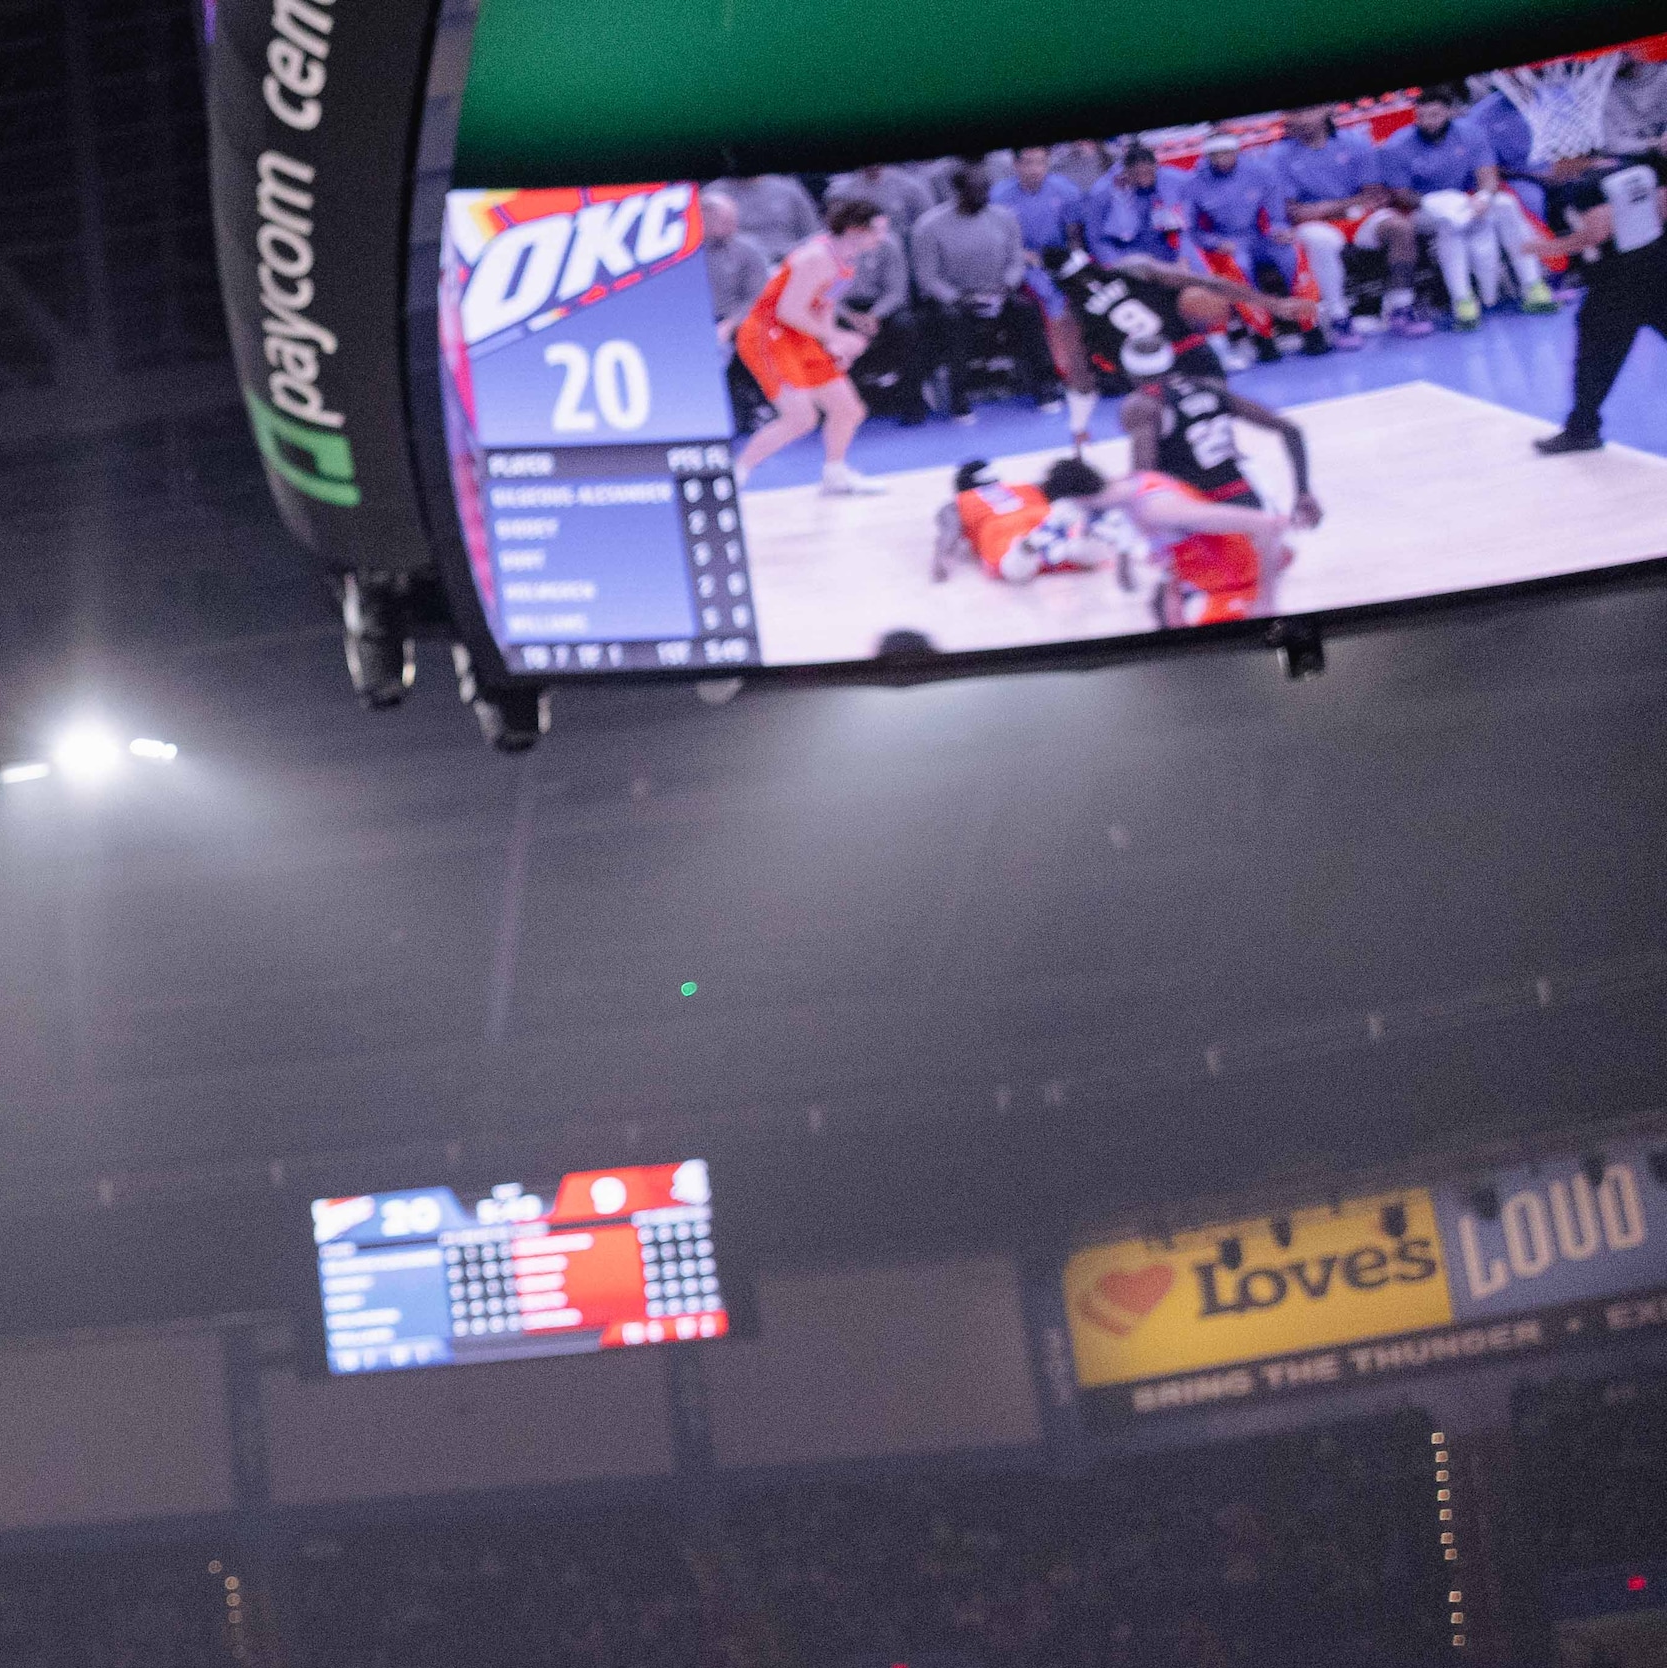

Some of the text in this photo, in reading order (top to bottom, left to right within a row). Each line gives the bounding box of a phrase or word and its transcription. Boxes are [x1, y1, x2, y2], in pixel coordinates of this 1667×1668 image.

[256, 0, 345, 428] paycom cen
[460, 184, 694, 346] OKC
[544, 339, 651, 434] 20
[1459, 1163, 1648, 1299] LOUD
[1262, 1353, 1342, 1390] THE
[1347, 1319, 1544, 1374] THUNDER
